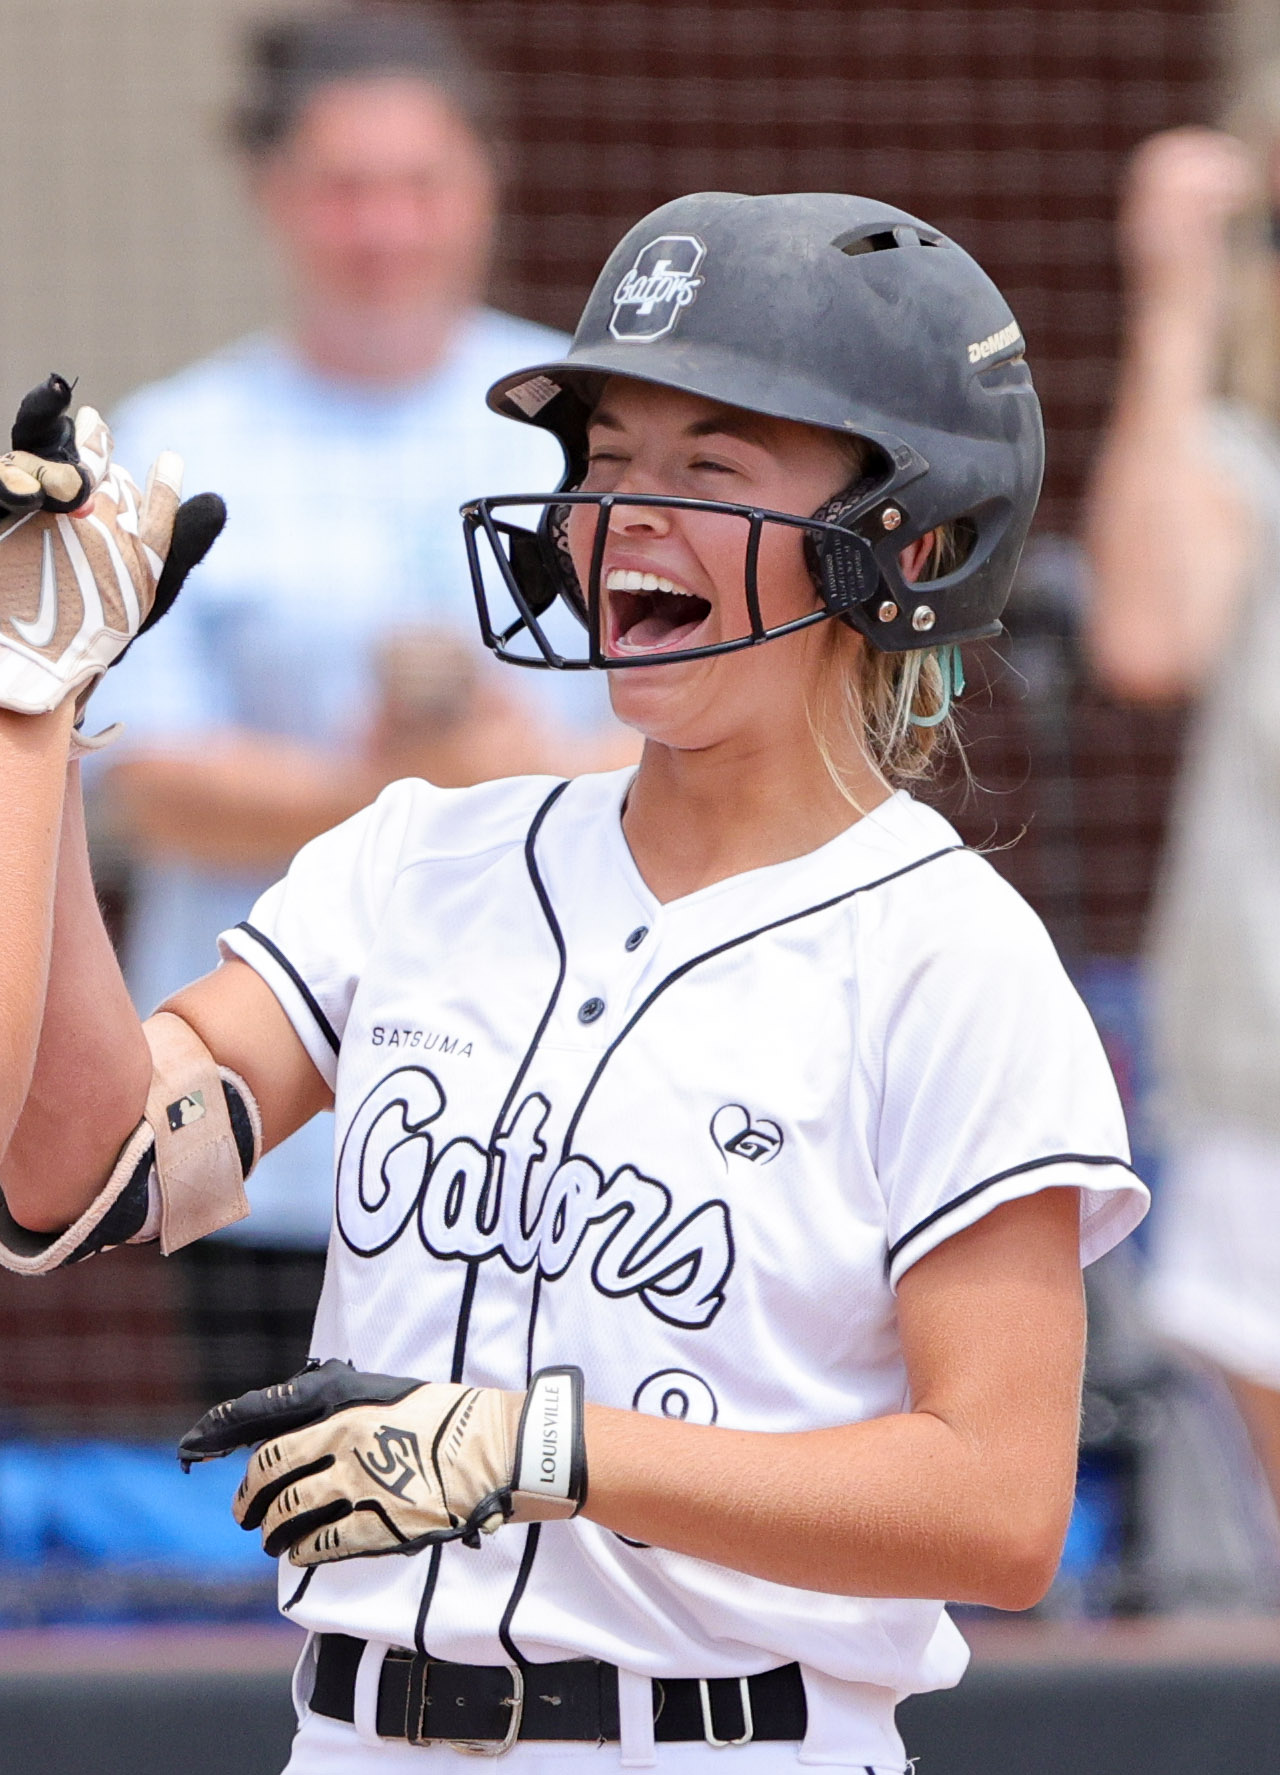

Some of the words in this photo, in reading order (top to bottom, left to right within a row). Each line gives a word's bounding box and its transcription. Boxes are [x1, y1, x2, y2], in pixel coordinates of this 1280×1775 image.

[613, 268, 702, 306] Gators
[371, 1026, 474, 1058] SATSUMA
[336, 1065, 735, 1330] Gators
[540, 1385, 560, 1484] LOUISVILLE
